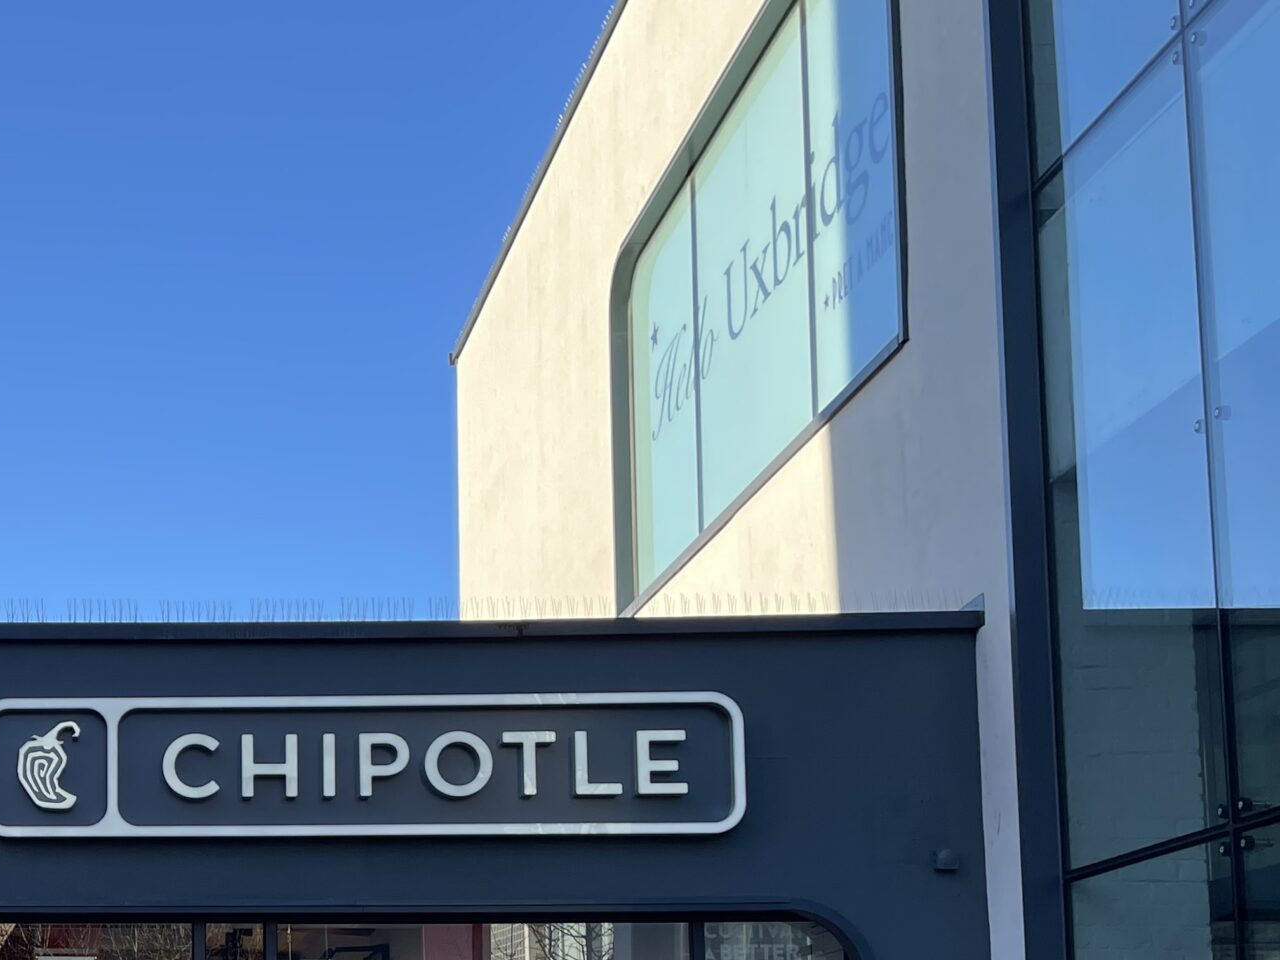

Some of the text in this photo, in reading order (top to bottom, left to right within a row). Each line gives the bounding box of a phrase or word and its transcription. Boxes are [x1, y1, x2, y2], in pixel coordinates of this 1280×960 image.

[651, 91, 890, 442] Hello Uxbridge
[831, 255, 853, 311] PRET
[161, 729, 689, 800] CHIPOTLE
[721, 944, 801, 960] BETTER
